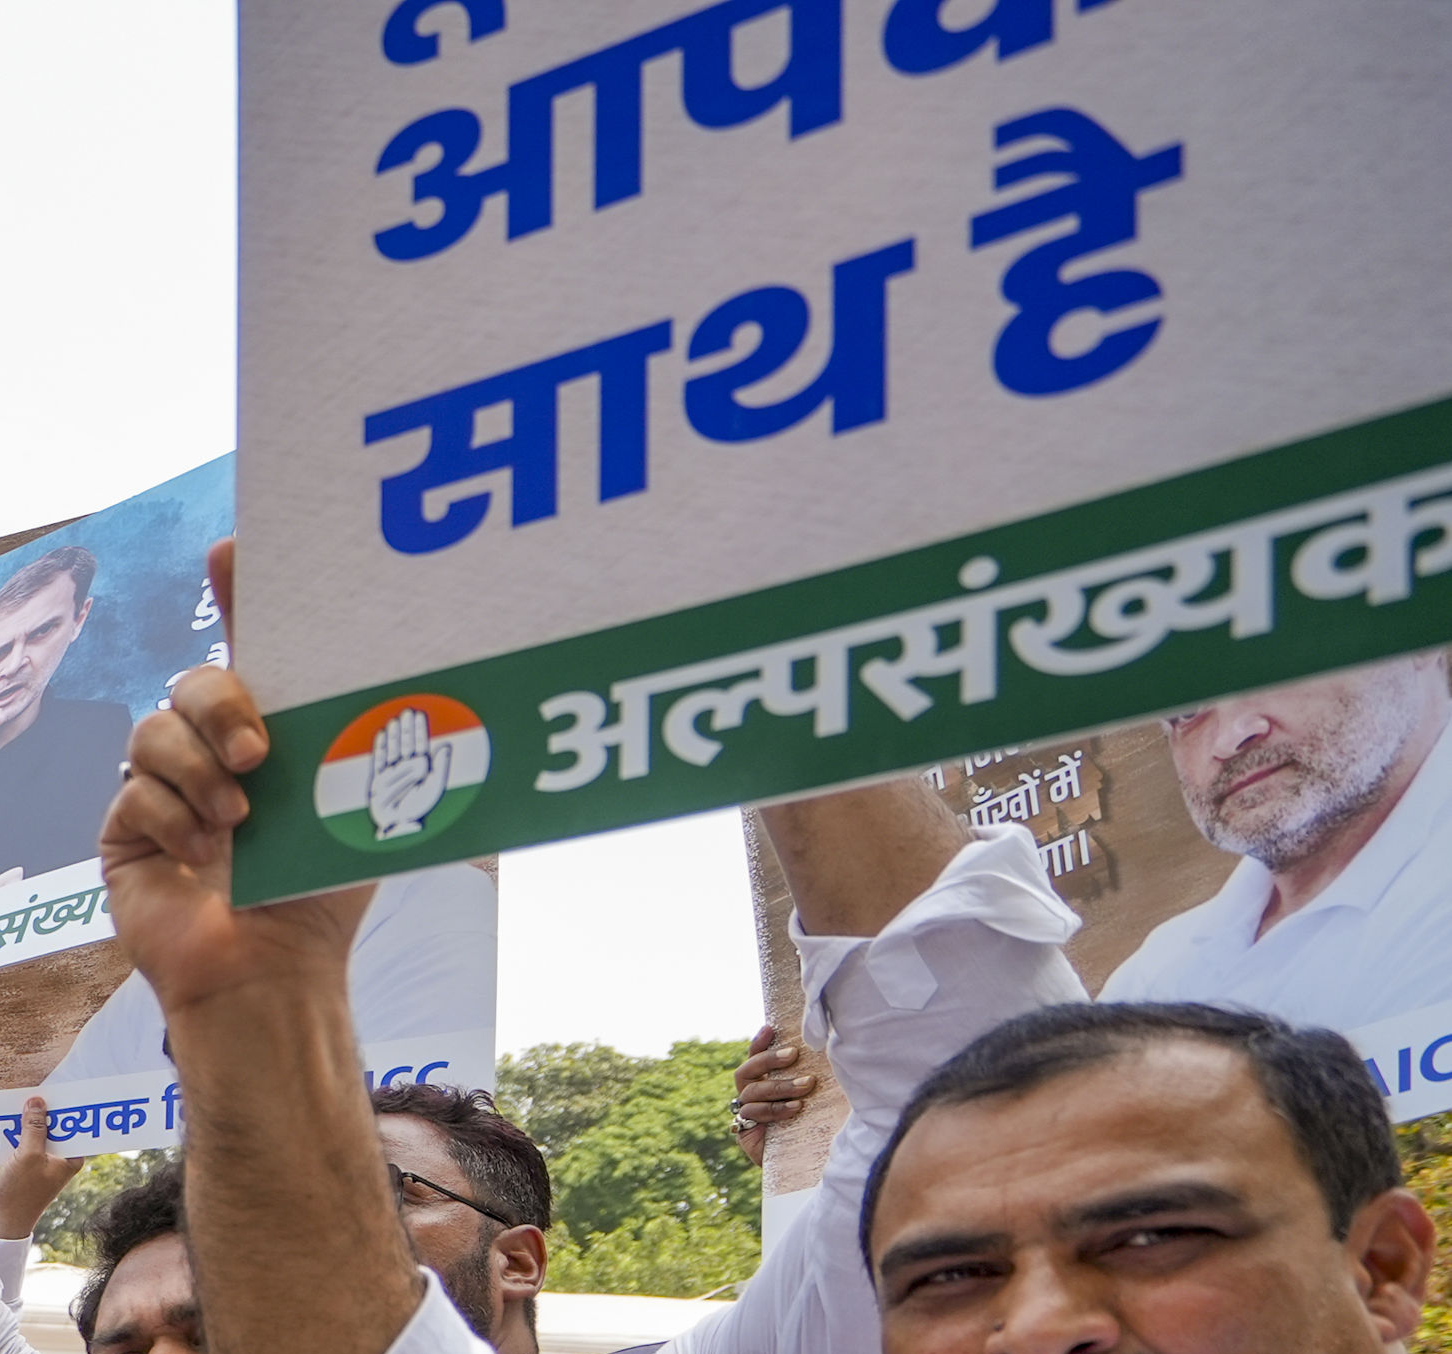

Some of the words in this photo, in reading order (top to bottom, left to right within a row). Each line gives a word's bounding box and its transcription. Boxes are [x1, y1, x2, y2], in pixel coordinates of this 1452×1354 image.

[364, 237, 917, 556] साथ
[970, 105, 1187, 398] है
[533, 461, 1452, 793] अल्पसंख्यक
[1045, 750, 1083, 804] में
